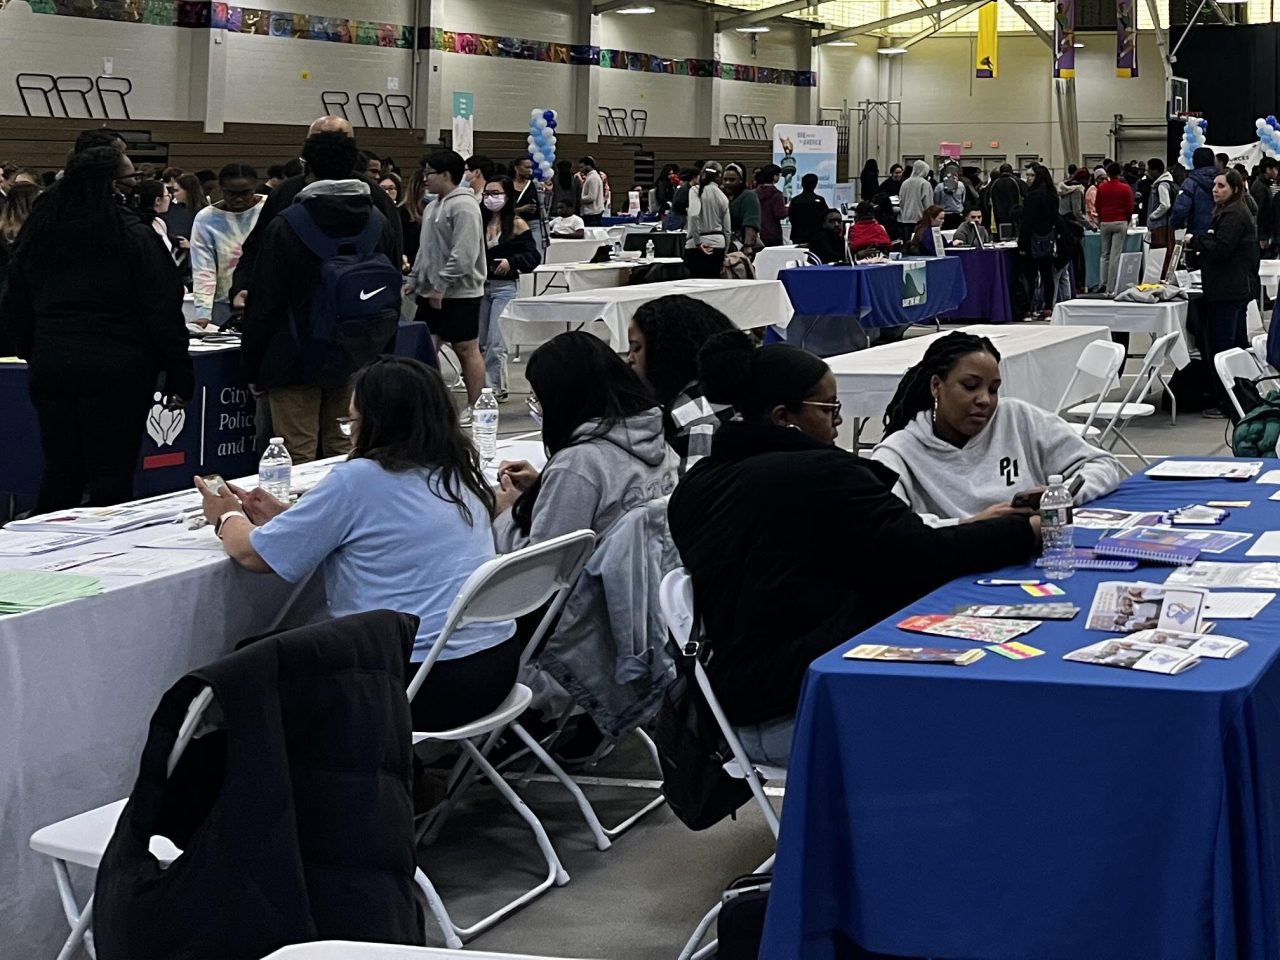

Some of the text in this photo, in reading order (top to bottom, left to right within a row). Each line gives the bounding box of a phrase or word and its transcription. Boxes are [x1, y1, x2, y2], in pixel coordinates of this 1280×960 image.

[220, 386, 250, 408] City
[218, 411, 254, 431] Polic
[217, 435, 246, 457] and
